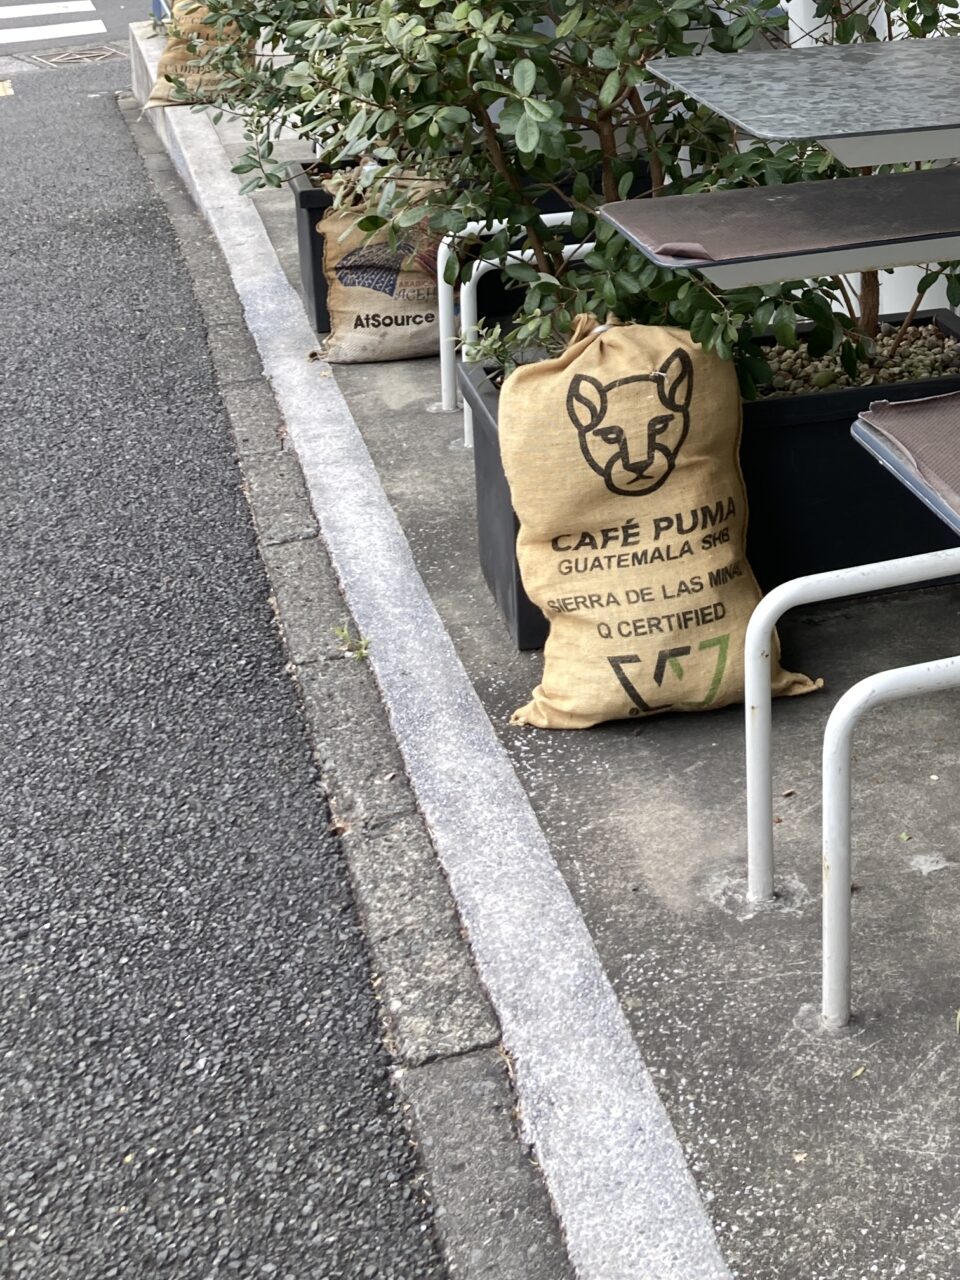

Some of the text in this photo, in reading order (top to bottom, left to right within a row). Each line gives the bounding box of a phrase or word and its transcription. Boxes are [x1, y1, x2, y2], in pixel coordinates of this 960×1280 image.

[354, 312, 435, 329] AtSource
[551, 496, 736, 552] CAFÉ PUMA
[558, 526, 730, 575] GUATEMALA SHB
[547, 591, 620, 615] SIERRA
[626, 587, 653, 605] DE
[661, 576, 704, 601] LAS
[597, 601, 727, 639] Q CERTIFIED
